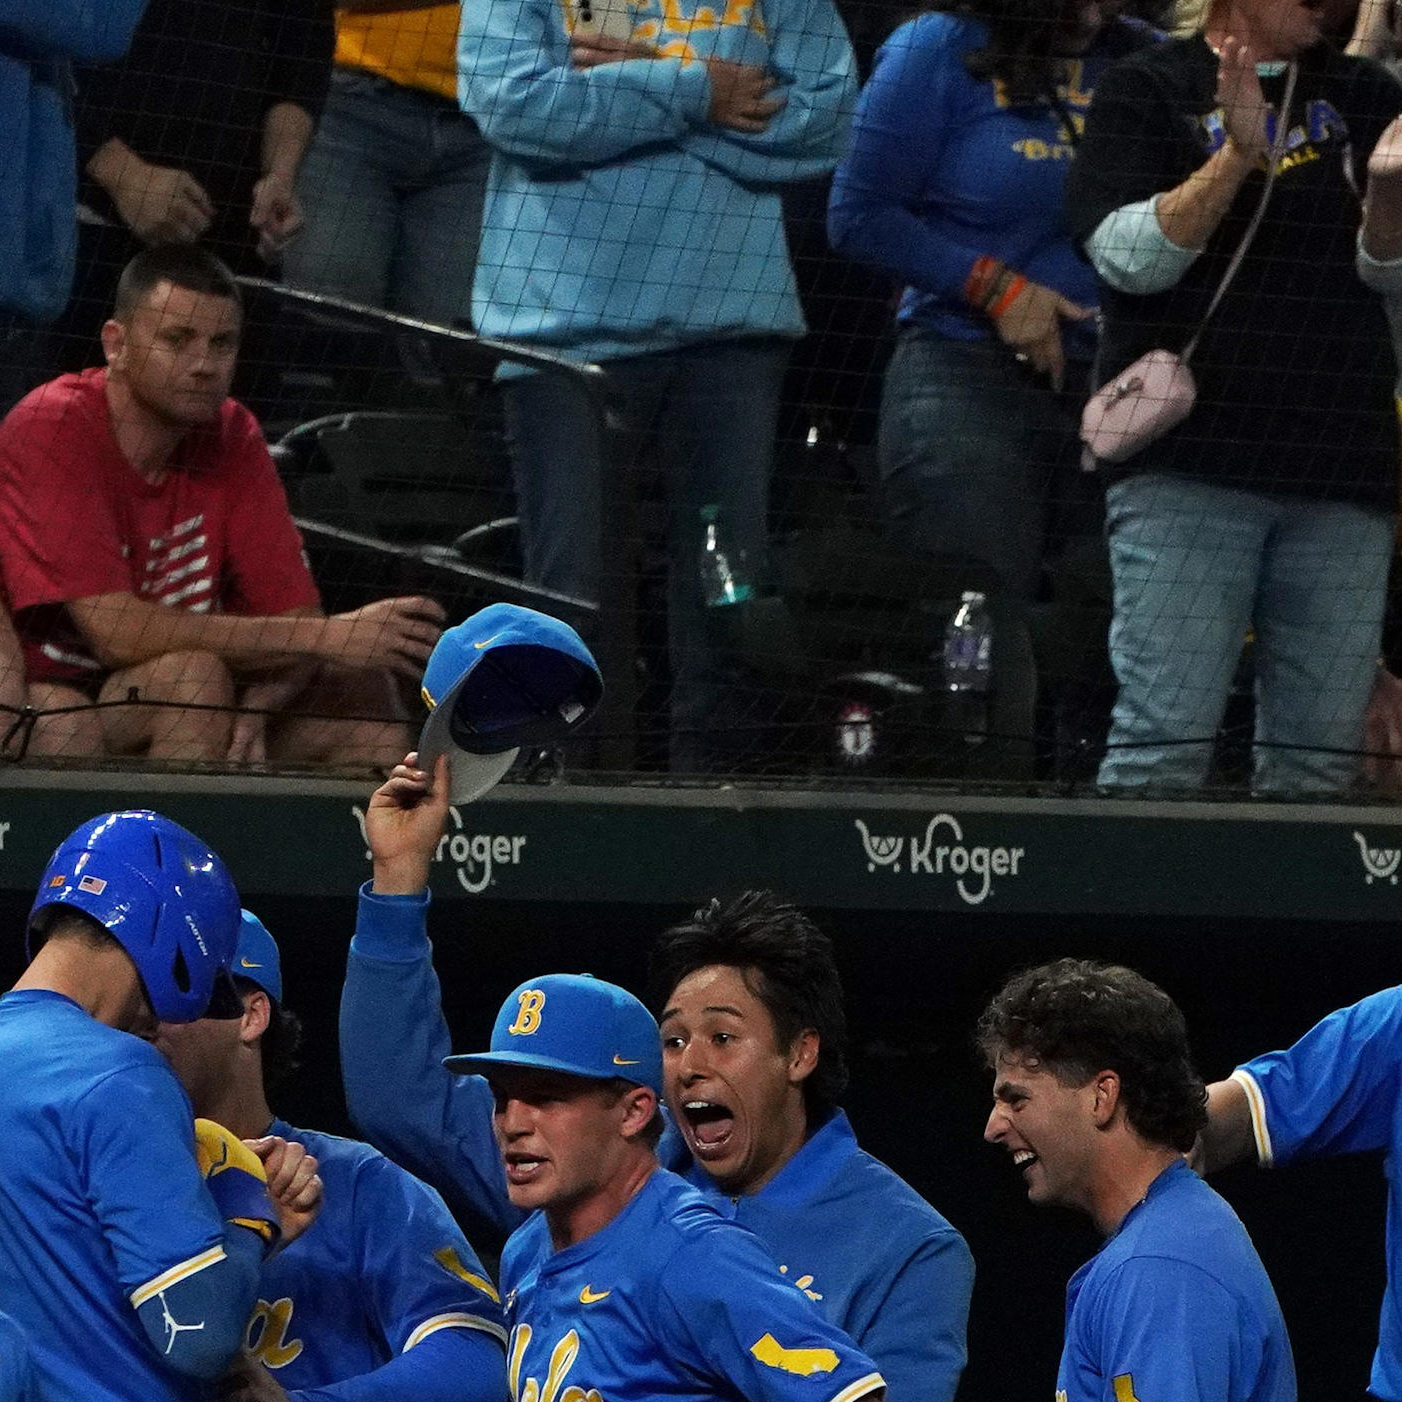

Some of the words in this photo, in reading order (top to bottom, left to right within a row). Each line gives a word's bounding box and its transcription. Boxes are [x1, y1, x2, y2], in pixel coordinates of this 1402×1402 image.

[431, 806, 527, 893] roger
[911, 814, 1024, 904] Kroger
[508, 989, 546, 1036] B
